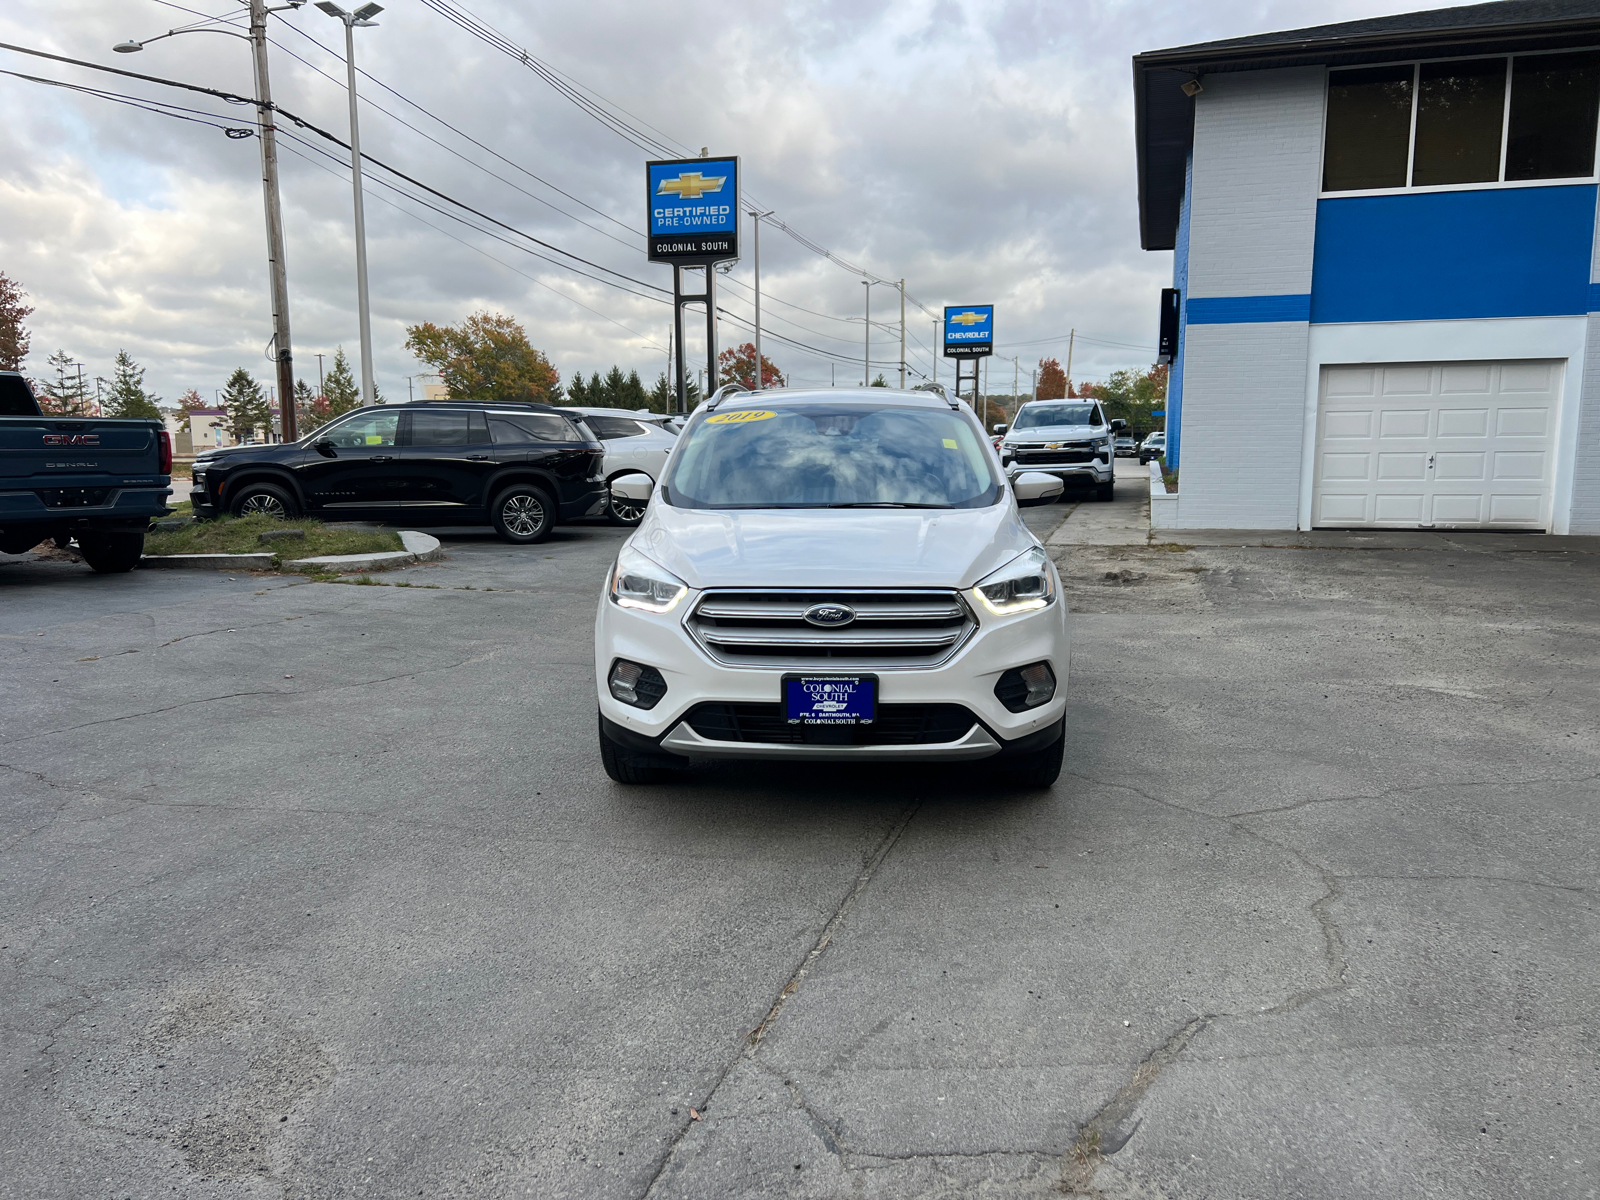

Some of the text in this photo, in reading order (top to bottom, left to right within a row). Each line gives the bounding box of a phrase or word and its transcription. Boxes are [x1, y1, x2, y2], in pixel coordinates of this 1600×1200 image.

[654, 205, 730, 218] CERTIFIED
[658, 215, 726, 226] PRE-OWNED
[656, 241, 728, 252] COLONIAL SOUTH
[947, 331, 989, 339] CHEVROLET
[715, 411, 766, 422] 2019
[42, 434, 100, 445] GMC
[816, 608, 843, 620] Ford
[803, 684, 857, 693] COLONIAL
[811, 692, 848, 701] SOUTH
